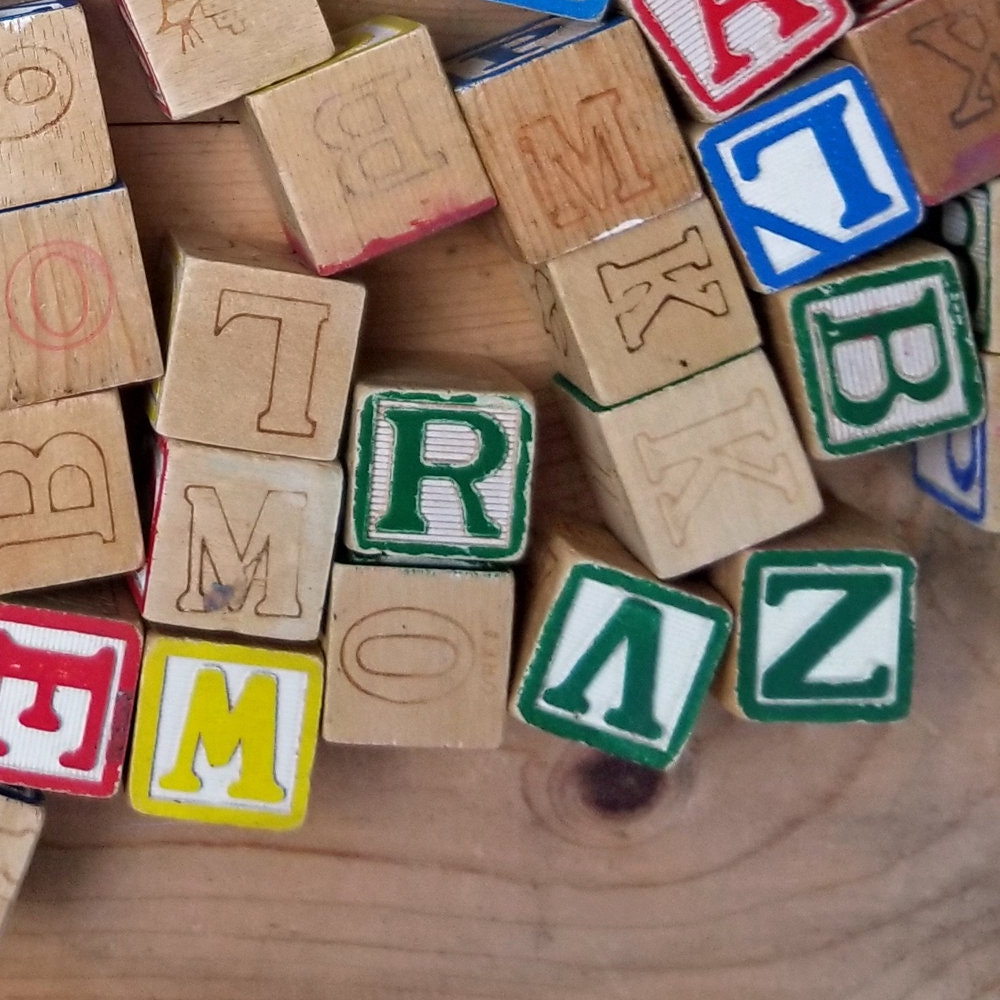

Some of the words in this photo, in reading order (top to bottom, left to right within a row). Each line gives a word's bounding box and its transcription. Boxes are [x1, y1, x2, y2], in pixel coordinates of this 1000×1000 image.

[518, 87, 657, 230] M
[731, 93, 894, 230] L
[597, 225, 729, 354] K
[811, 286, 953, 427] B
[376, 407, 511, 539] R
[633, 387, 795, 548] K
[176, 485, 308, 618] M
[158, 664, 286, 803] M
